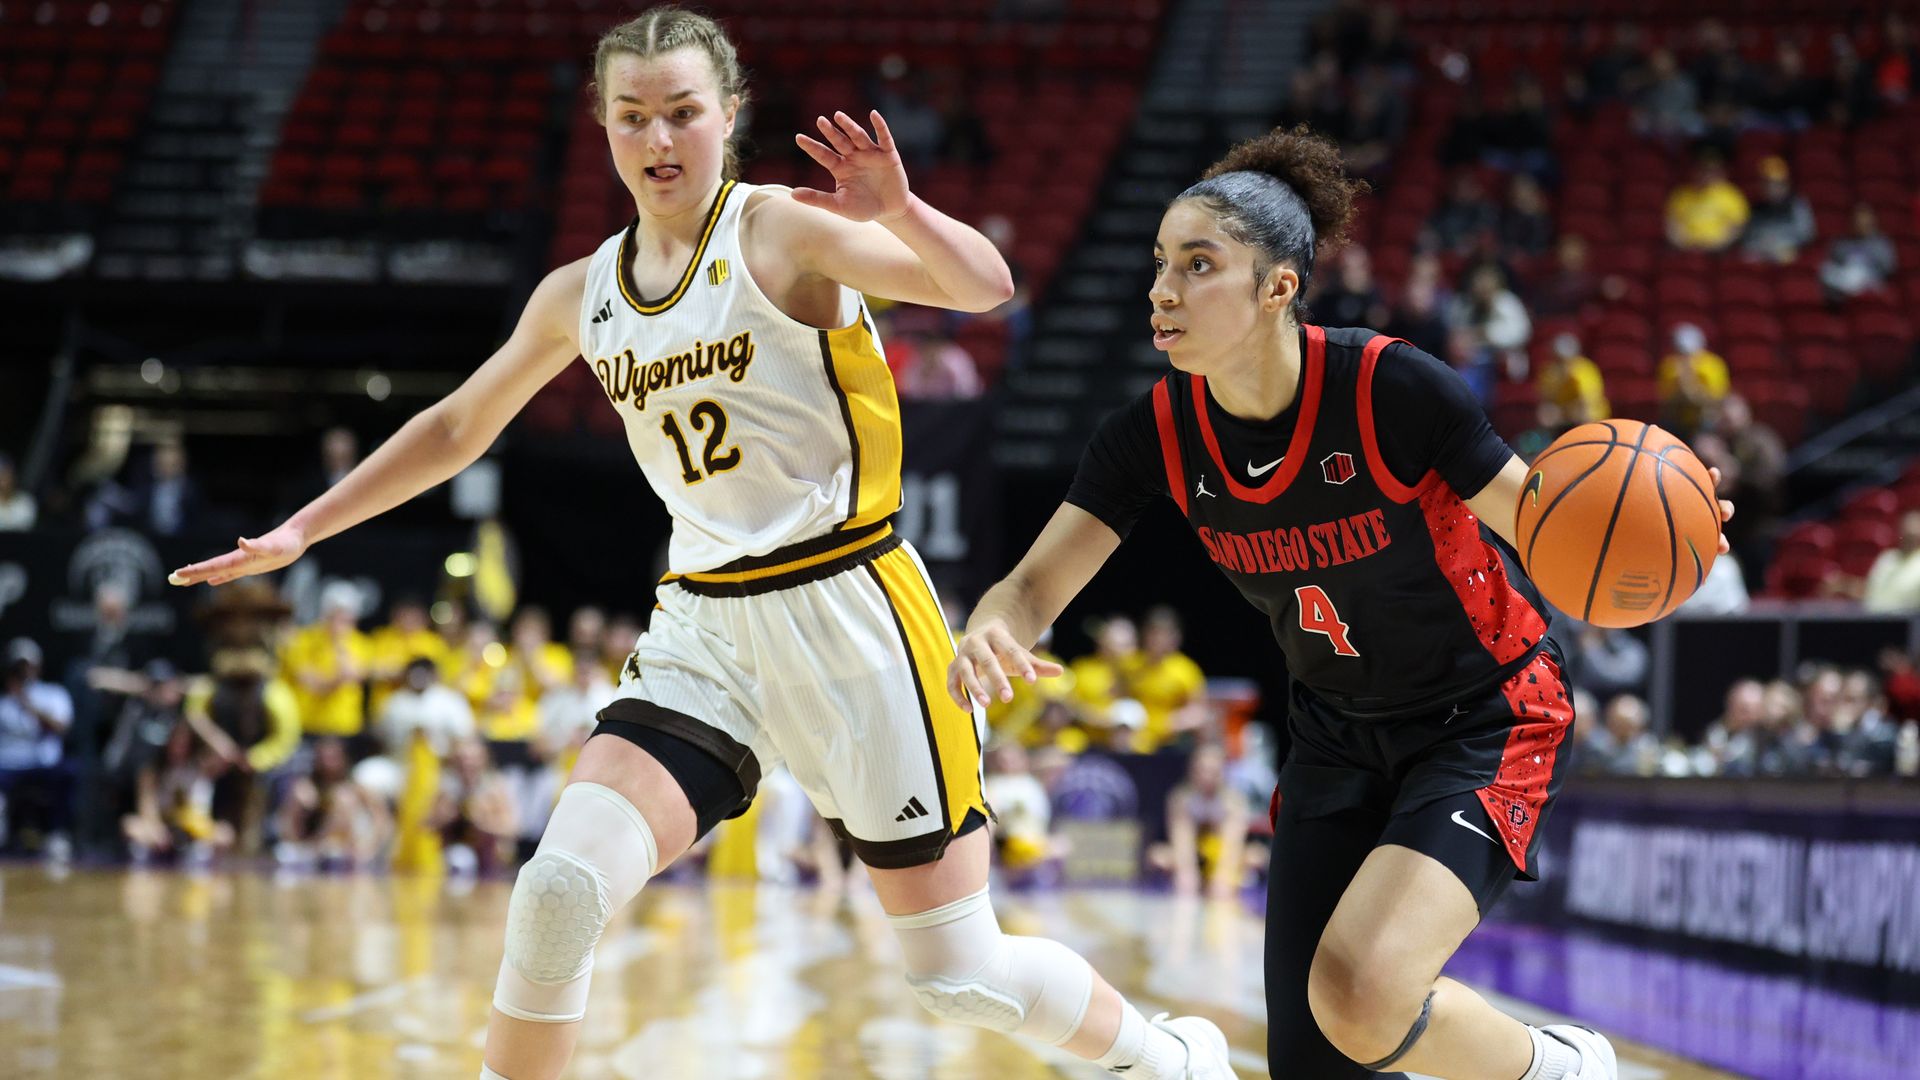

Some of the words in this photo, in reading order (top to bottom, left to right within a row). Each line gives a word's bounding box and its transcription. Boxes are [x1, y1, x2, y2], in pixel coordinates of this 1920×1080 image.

[596, 330, 755, 411] Wyoming
[660, 398, 744, 487] 12
[1198, 526, 1243, 573] SAN
[1232, 526, 1310, 573] DIEGO
[1307, 508, 1392, 569] STATE
[1295, 584, 1361, 657] 4
